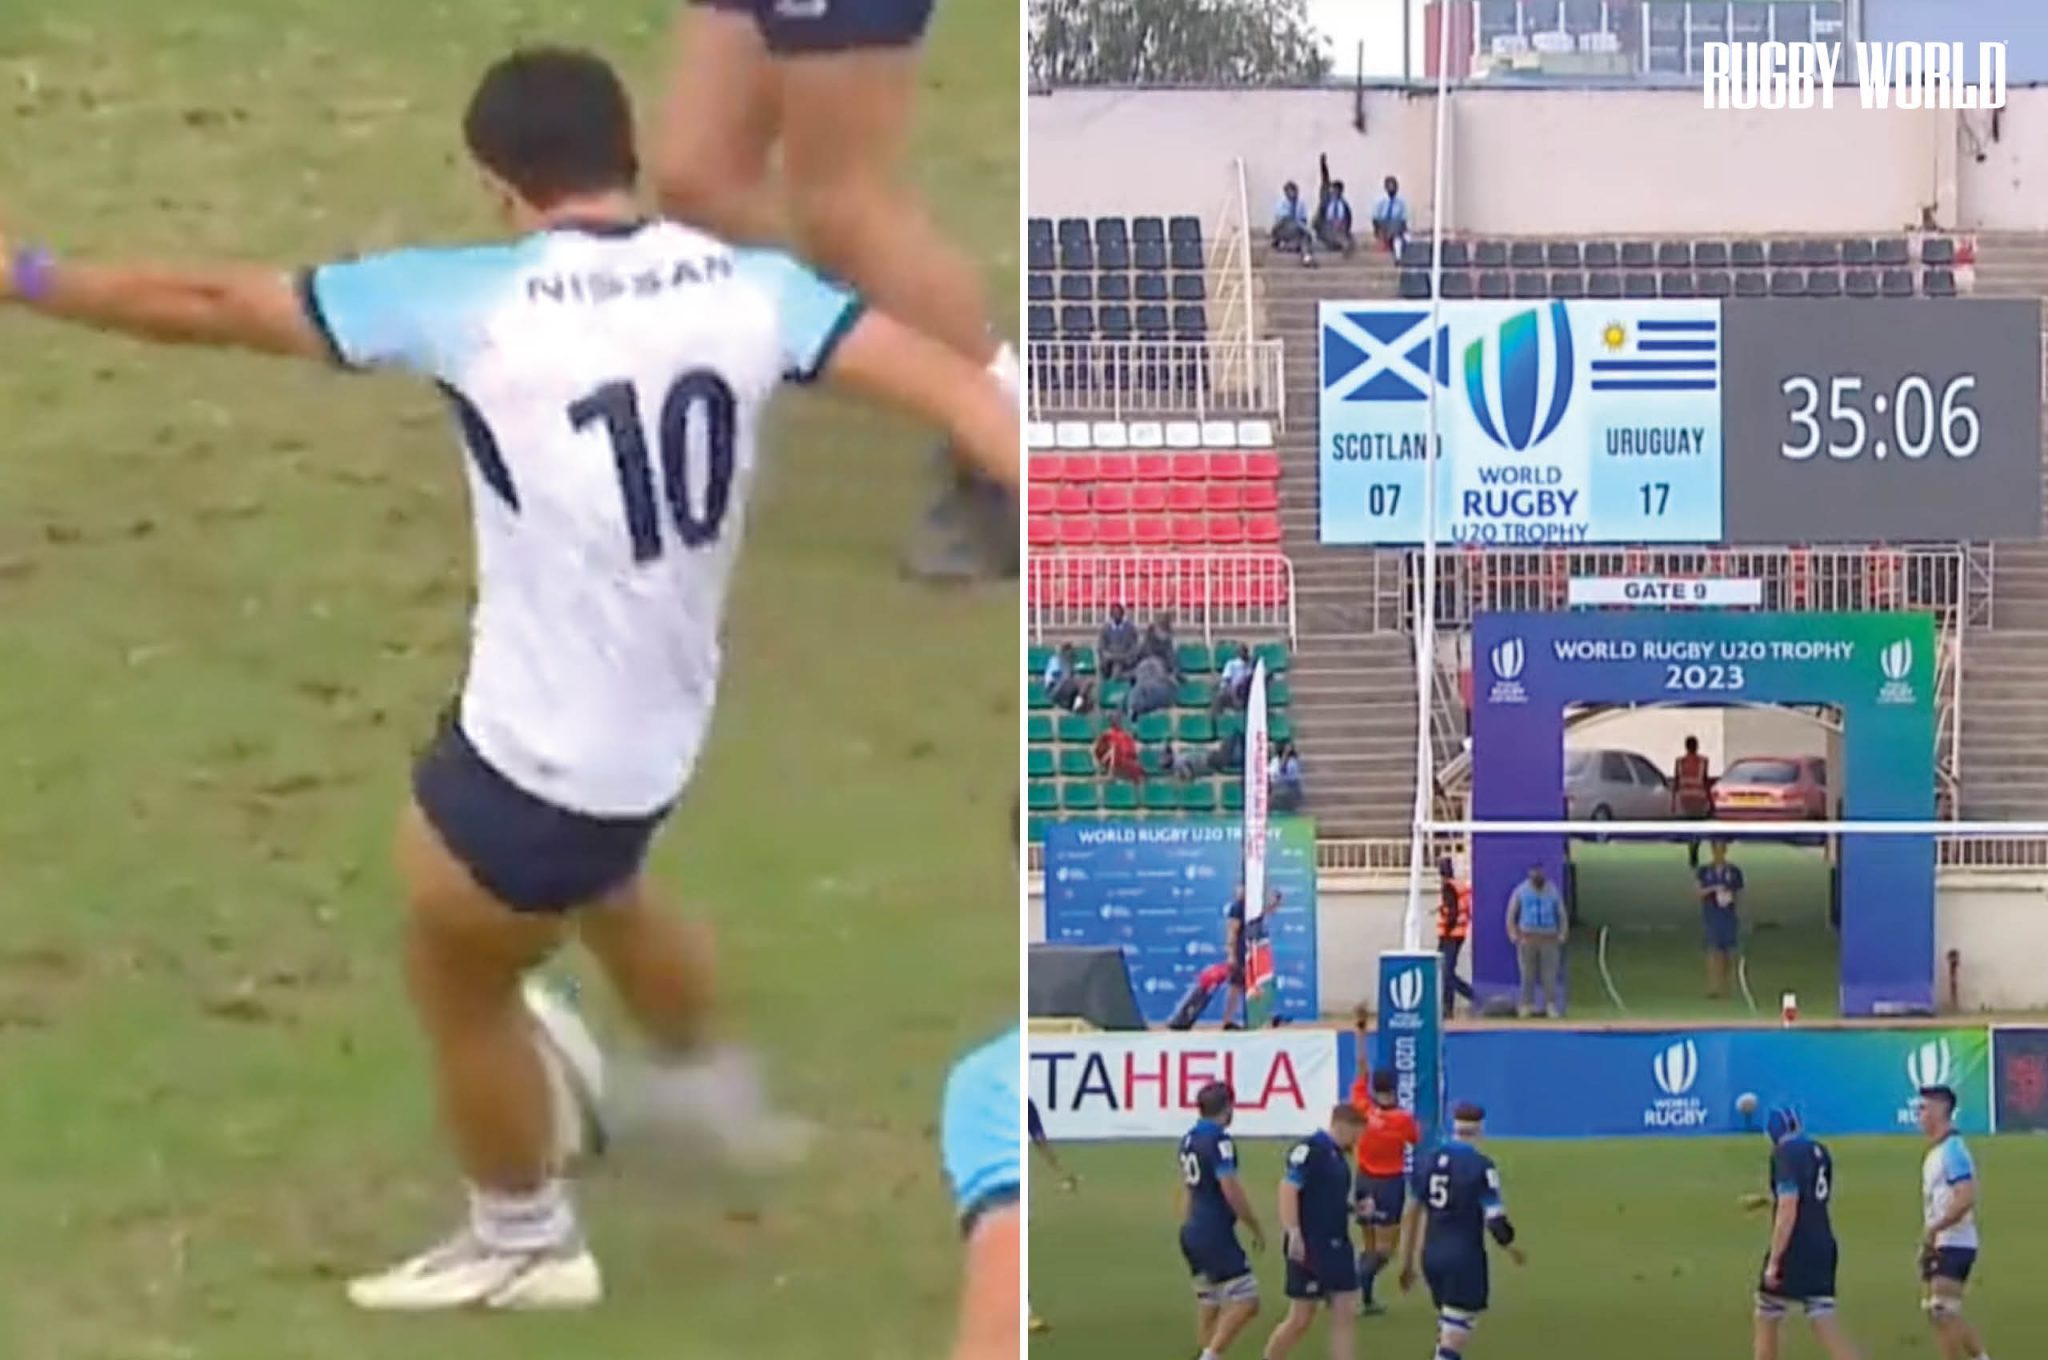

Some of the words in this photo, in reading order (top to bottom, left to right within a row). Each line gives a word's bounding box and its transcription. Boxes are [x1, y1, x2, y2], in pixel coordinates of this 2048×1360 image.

[527, 256, 733, 302] NISSAN
[1781, 375, 1980, 459] 35:06
[1606, 427, 1704, 456] URUGUAY
[567, 367, 737, 561] 10
[1478, 466, 1562, 485] WORLD
[1369, 484, 1401, 516] 07
[1463, 489, 1579, 517] RUGBY
[1640, 482, 1671, 515] 17
[1451, 522, 1497, 544] U20
[1502, 522, 1589, 544] TROPHY
[1624, 582, 1686, 599] GATE
[1694, 583, 1707, 599] 9
[1555, 640, 1636, 660] WORLD
[1643, 640, 1714, 660] RUGBY
[1720, 640, 1767, 660] U20
[1770, 640, 1855, 660] TROPHY
[1665, 664, 1745, 690] 2023
[1079, 830, 1136, 844] WORLD
[1139, 829, 1189, 842] RUGBY
[1644, 1108, 1708, 1127] RUGBY
[1181, 1152, 1200, 1186] 0
[1815, 1165, 1828, 1200] 6
[1429, 1174, 1449, 1209] 5
